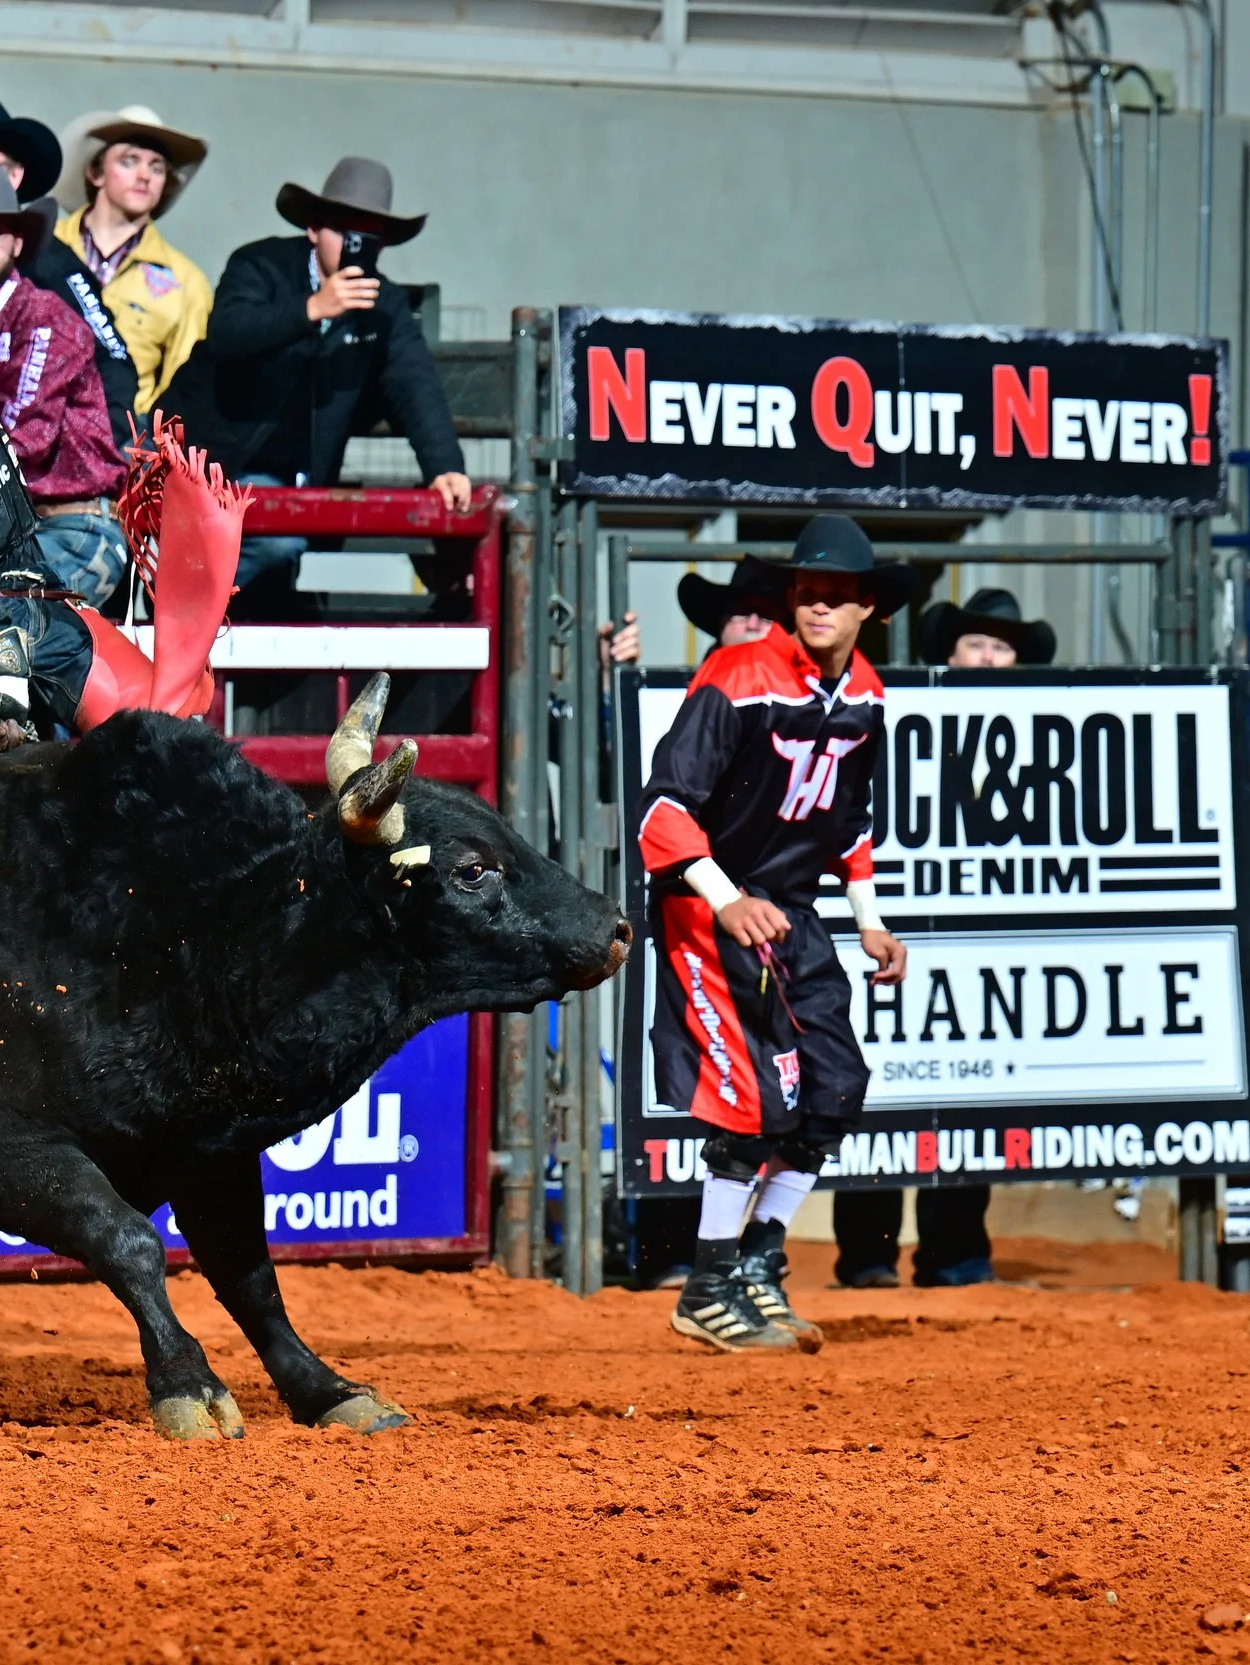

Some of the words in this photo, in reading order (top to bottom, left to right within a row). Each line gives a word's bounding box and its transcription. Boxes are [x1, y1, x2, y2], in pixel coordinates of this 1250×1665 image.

[872, 712, 1220, 849] CK&ROLL
[913, 856, 1090, 896] DENIM
[863, 962, 1205, 1044] HANDLE
[882, 1062, 941, 1081] SINCE
[949, 1060, 994, 1079] 1946
